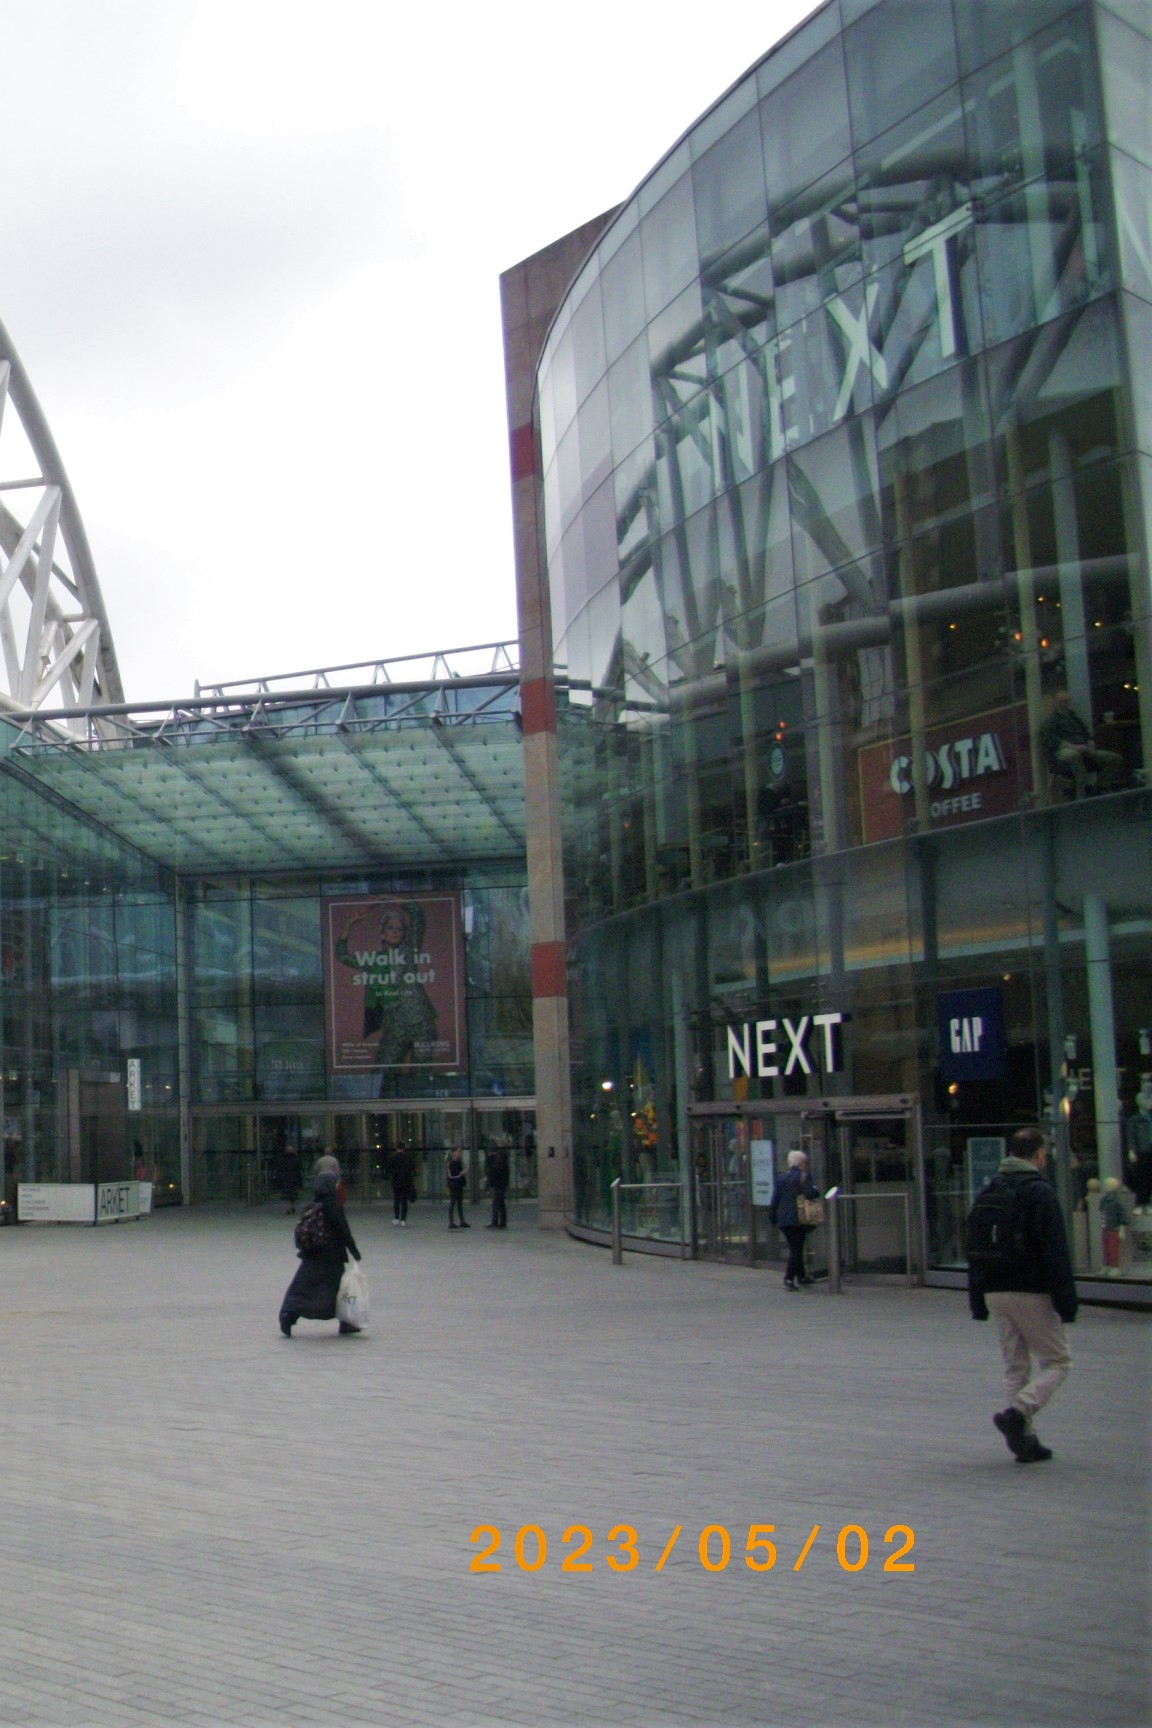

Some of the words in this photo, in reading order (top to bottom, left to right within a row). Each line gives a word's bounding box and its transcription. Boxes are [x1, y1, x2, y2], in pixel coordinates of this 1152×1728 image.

[708, 201, 971, 492] NEXT
[929, 793, 983, 818] OFFEE
[355, 949, 406, 966] Walk
[413, 949, 431, 965] in
[352, 972, 397, 986] strut
[403, 969, 436, 984] out
[727, 1013, 842, 1079] NEXT
[950, 1017, 982, 1054] GAP
[129, 1060, 137, 1109] ARKET
[100, 1187, 130, 1215] ARKET
